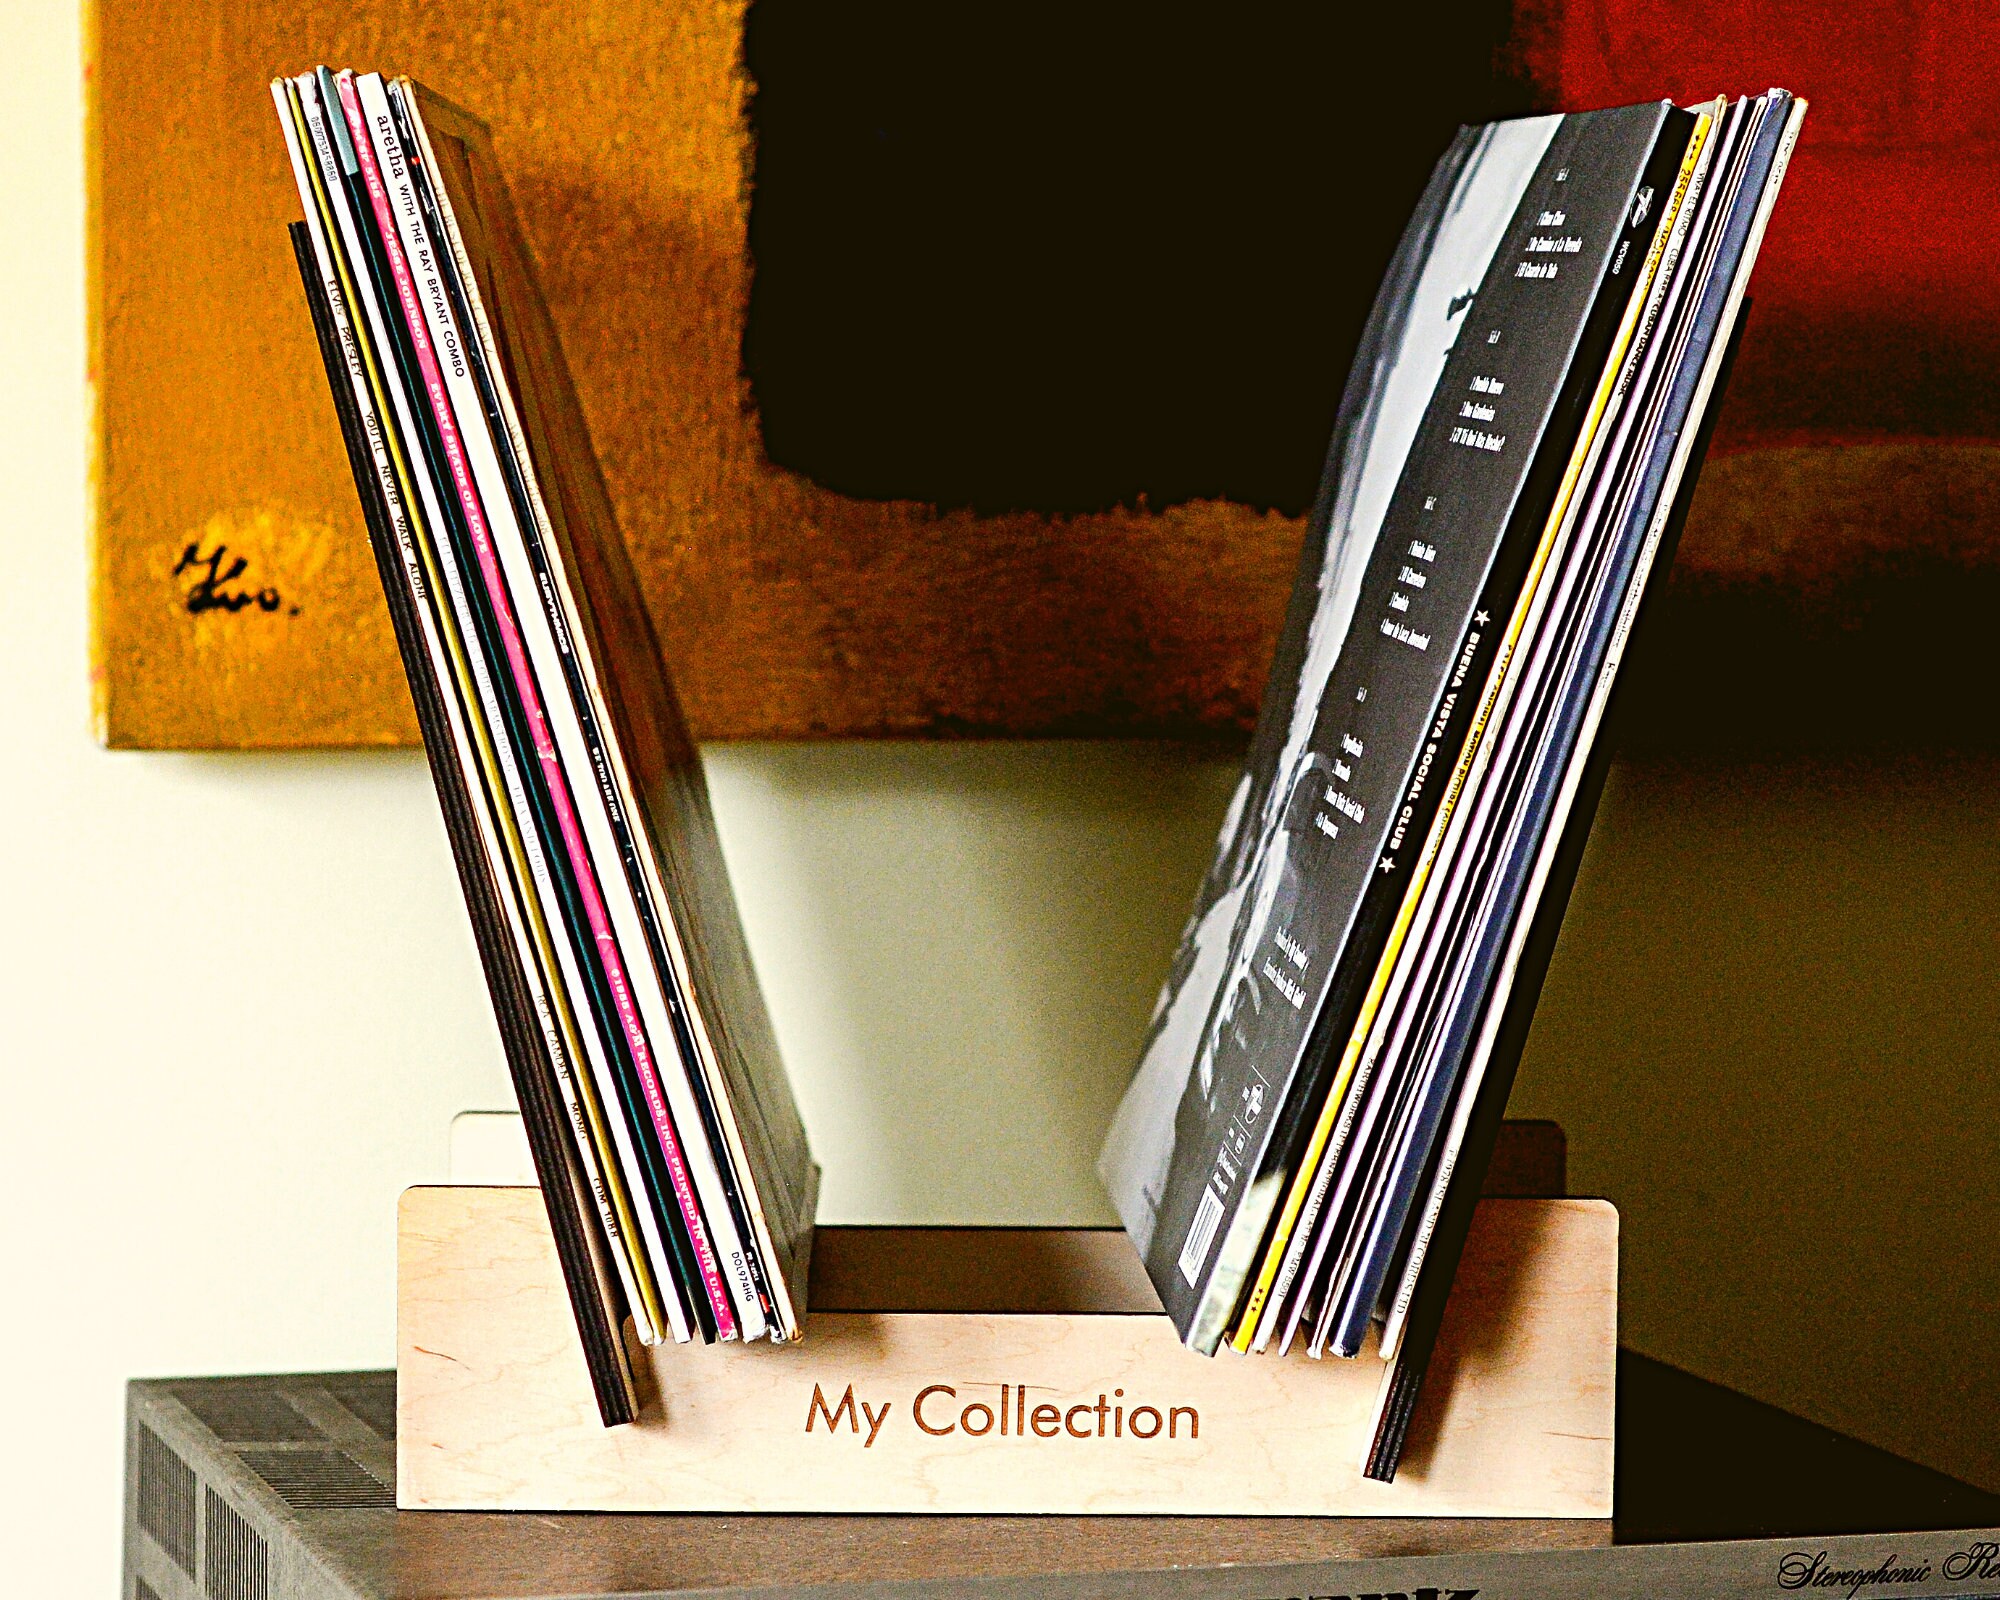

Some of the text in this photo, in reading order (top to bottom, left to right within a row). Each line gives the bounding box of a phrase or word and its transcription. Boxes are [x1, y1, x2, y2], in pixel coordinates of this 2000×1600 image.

[375, 113, 465, 378] aretha WITH THE RAY BRYANT COMBO
[1610, 239, 1631, 275] WCV050
[384, 229, 427, 349] JESSE JOHNSON
[326, 279, 363, 378] ELVIS PRESLEY
[1642, 303, 1660, 335] CUBAN
[1629, 336, 1647, 368] DANCE
[1617, 368, 1634, 397] MUSIC
[379, 464, 399, 506] NEVER
[394, 515, 412, 551] WALK
[408, 561, 427, 602] ALONE
[461, 489, 475, 511] OF
[469, 513, 488, 554] LOVE
[1449, 631, 1481, 689] BUENA
[1430, 690, 1458, 740] VISTA
[1406, 741, 1438, 803] SOCIAL
[1388, 804, 1414, 851] CLUB
[670, 1156, 697, 1221] PRINTED
[730, 1250, 754, 1302] DOL974HG
[805, 1382, 1200, 1448] My Collection
[1777, 1550, 1932, 1600] Stereophonic
